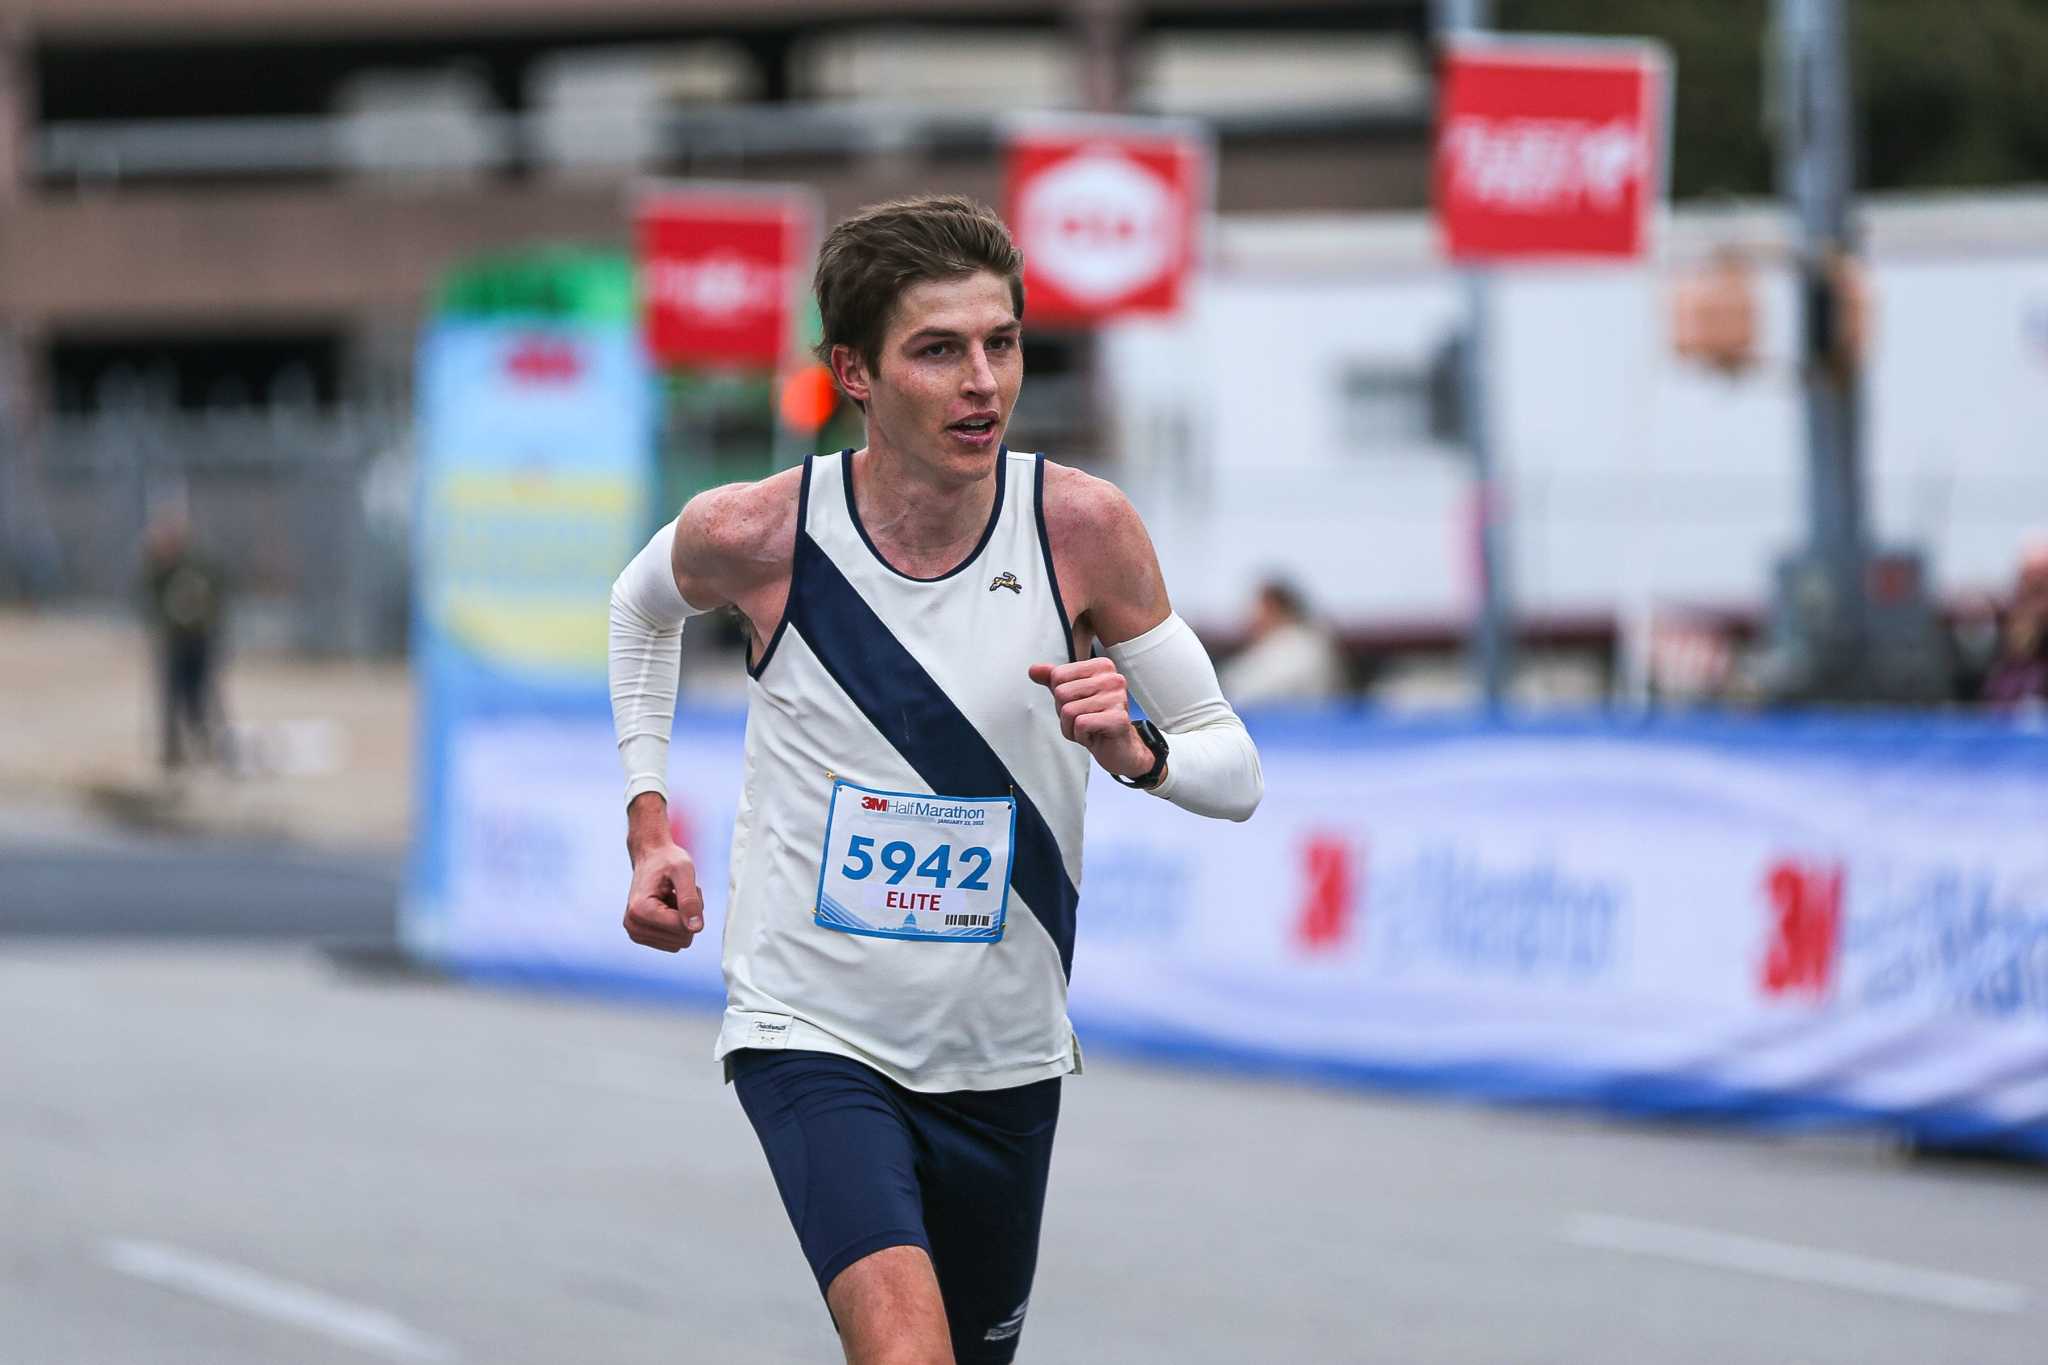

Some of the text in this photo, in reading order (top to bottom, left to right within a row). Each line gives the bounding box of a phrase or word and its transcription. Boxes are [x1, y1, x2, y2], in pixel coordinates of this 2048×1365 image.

[861, 796, 888, 812] 3M
[915, 803, 985, 819] Marathon
[841, 834, 992, 891] 5942
[886, 891, 942, 911] ELITE
